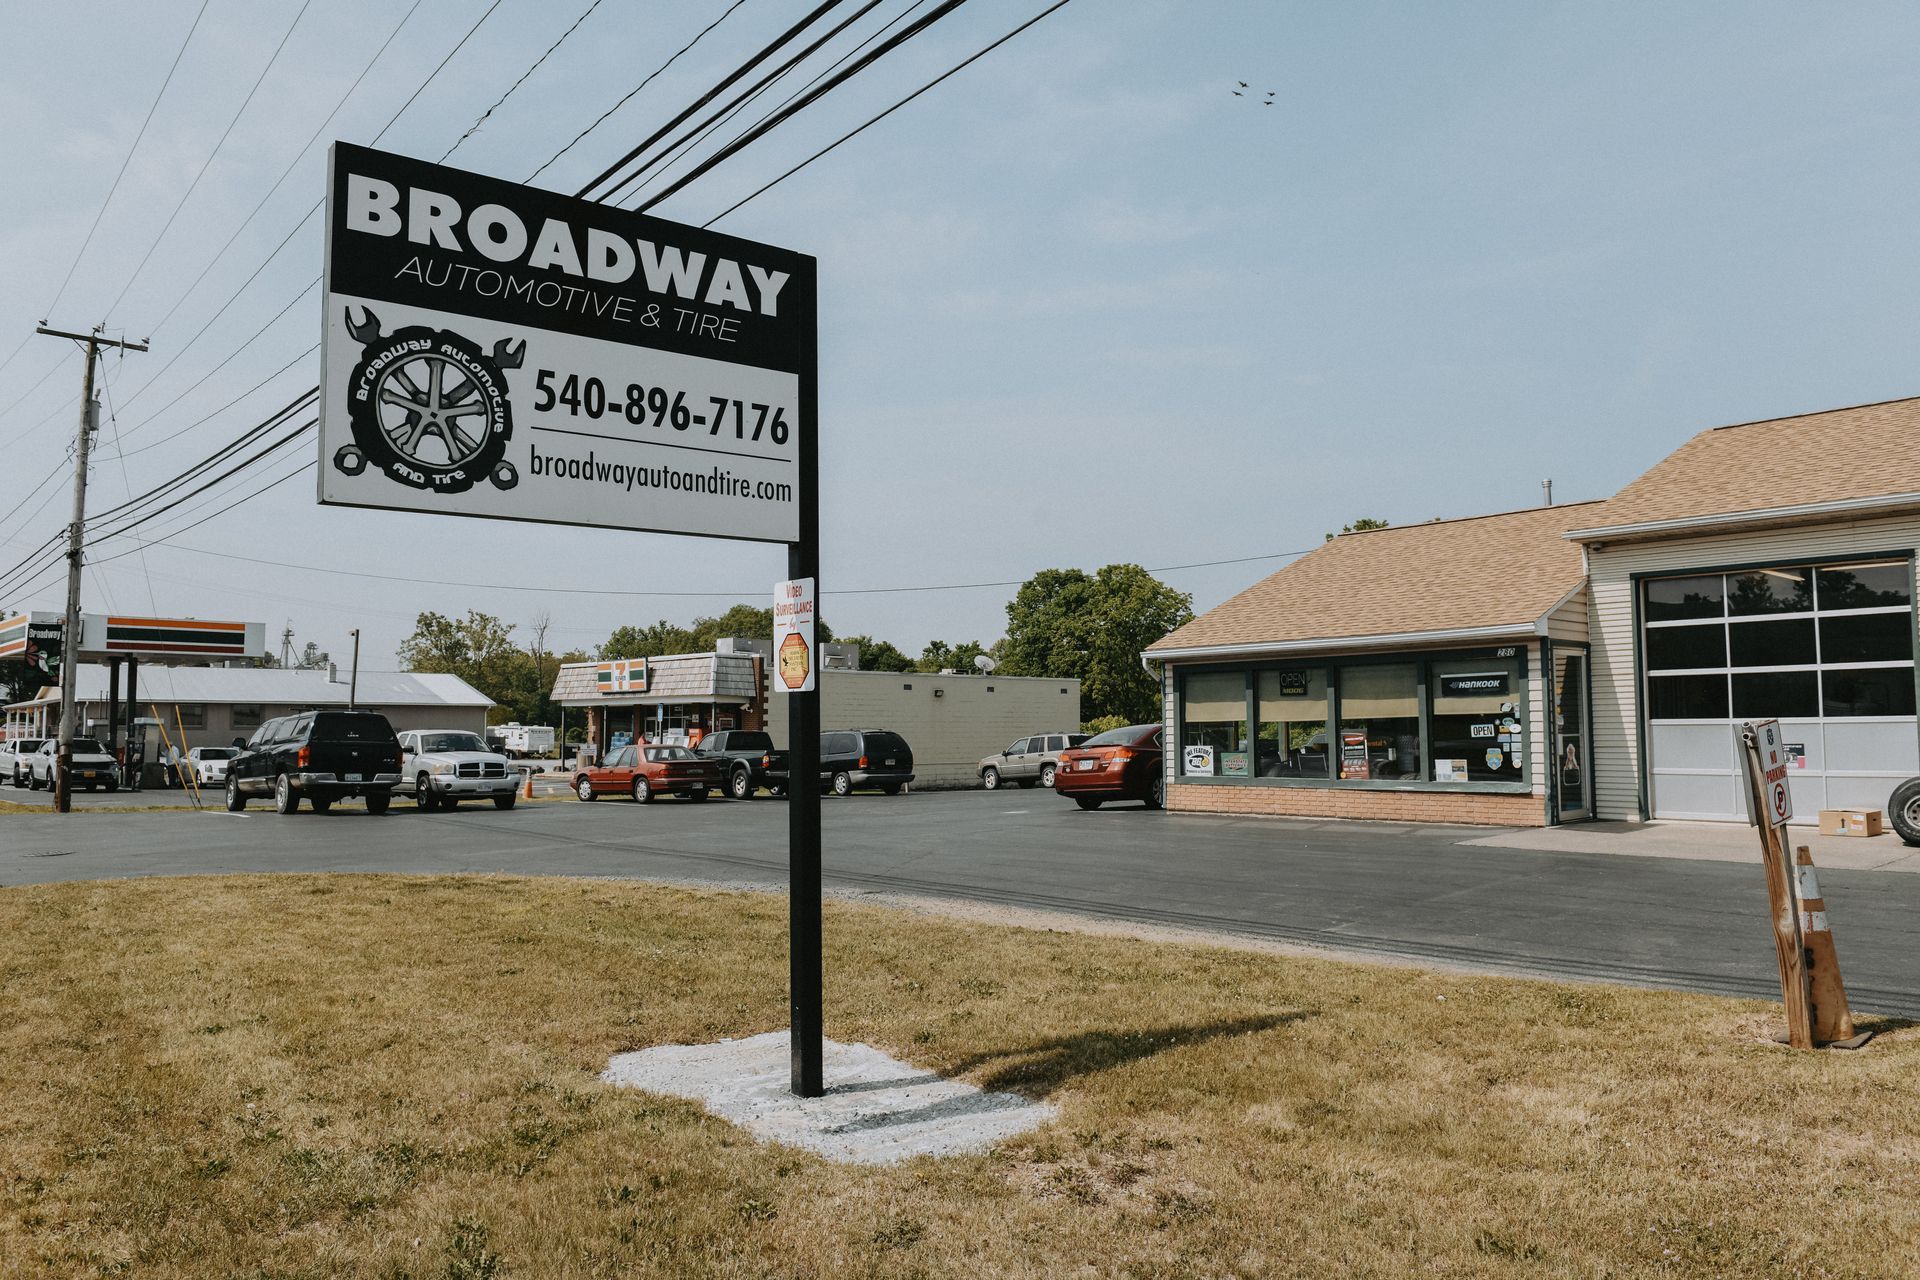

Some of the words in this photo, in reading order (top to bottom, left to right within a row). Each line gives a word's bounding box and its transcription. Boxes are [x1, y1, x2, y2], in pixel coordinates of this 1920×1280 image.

[346, 172, 791, 317] BROADWAY
[394, 256, 633, 323] AUTOMOTIVE
[640, 303, 662, 328] &
[673, 307, 742, 343] TIRE
[356, 339, 432, 401] Broadway
[440, 344, 504, 433] Automotive
[534, 369, 789, 445] 540-896-7176
[432, 469, 466, 485] Tire
[530, 444, 792, 502] broadwayautoandtire.com
[786, 585, 803, 599] VIDEO
[776, 600, 813, 617] SURVEILLANCE
[29, 628, 61, 640] Broadway
[1497, 648, 1516, 657] 280
[615, 662, 626, 689] 7
[1280, 673, 1306, 687] OPEN
[1458, 680, 1500, 689] Hankook
[1473, 726, 1493, 736] OPEN
[1769, 750, 1778, 765] NO
[1766, 765, 1786, 784] PARKING
